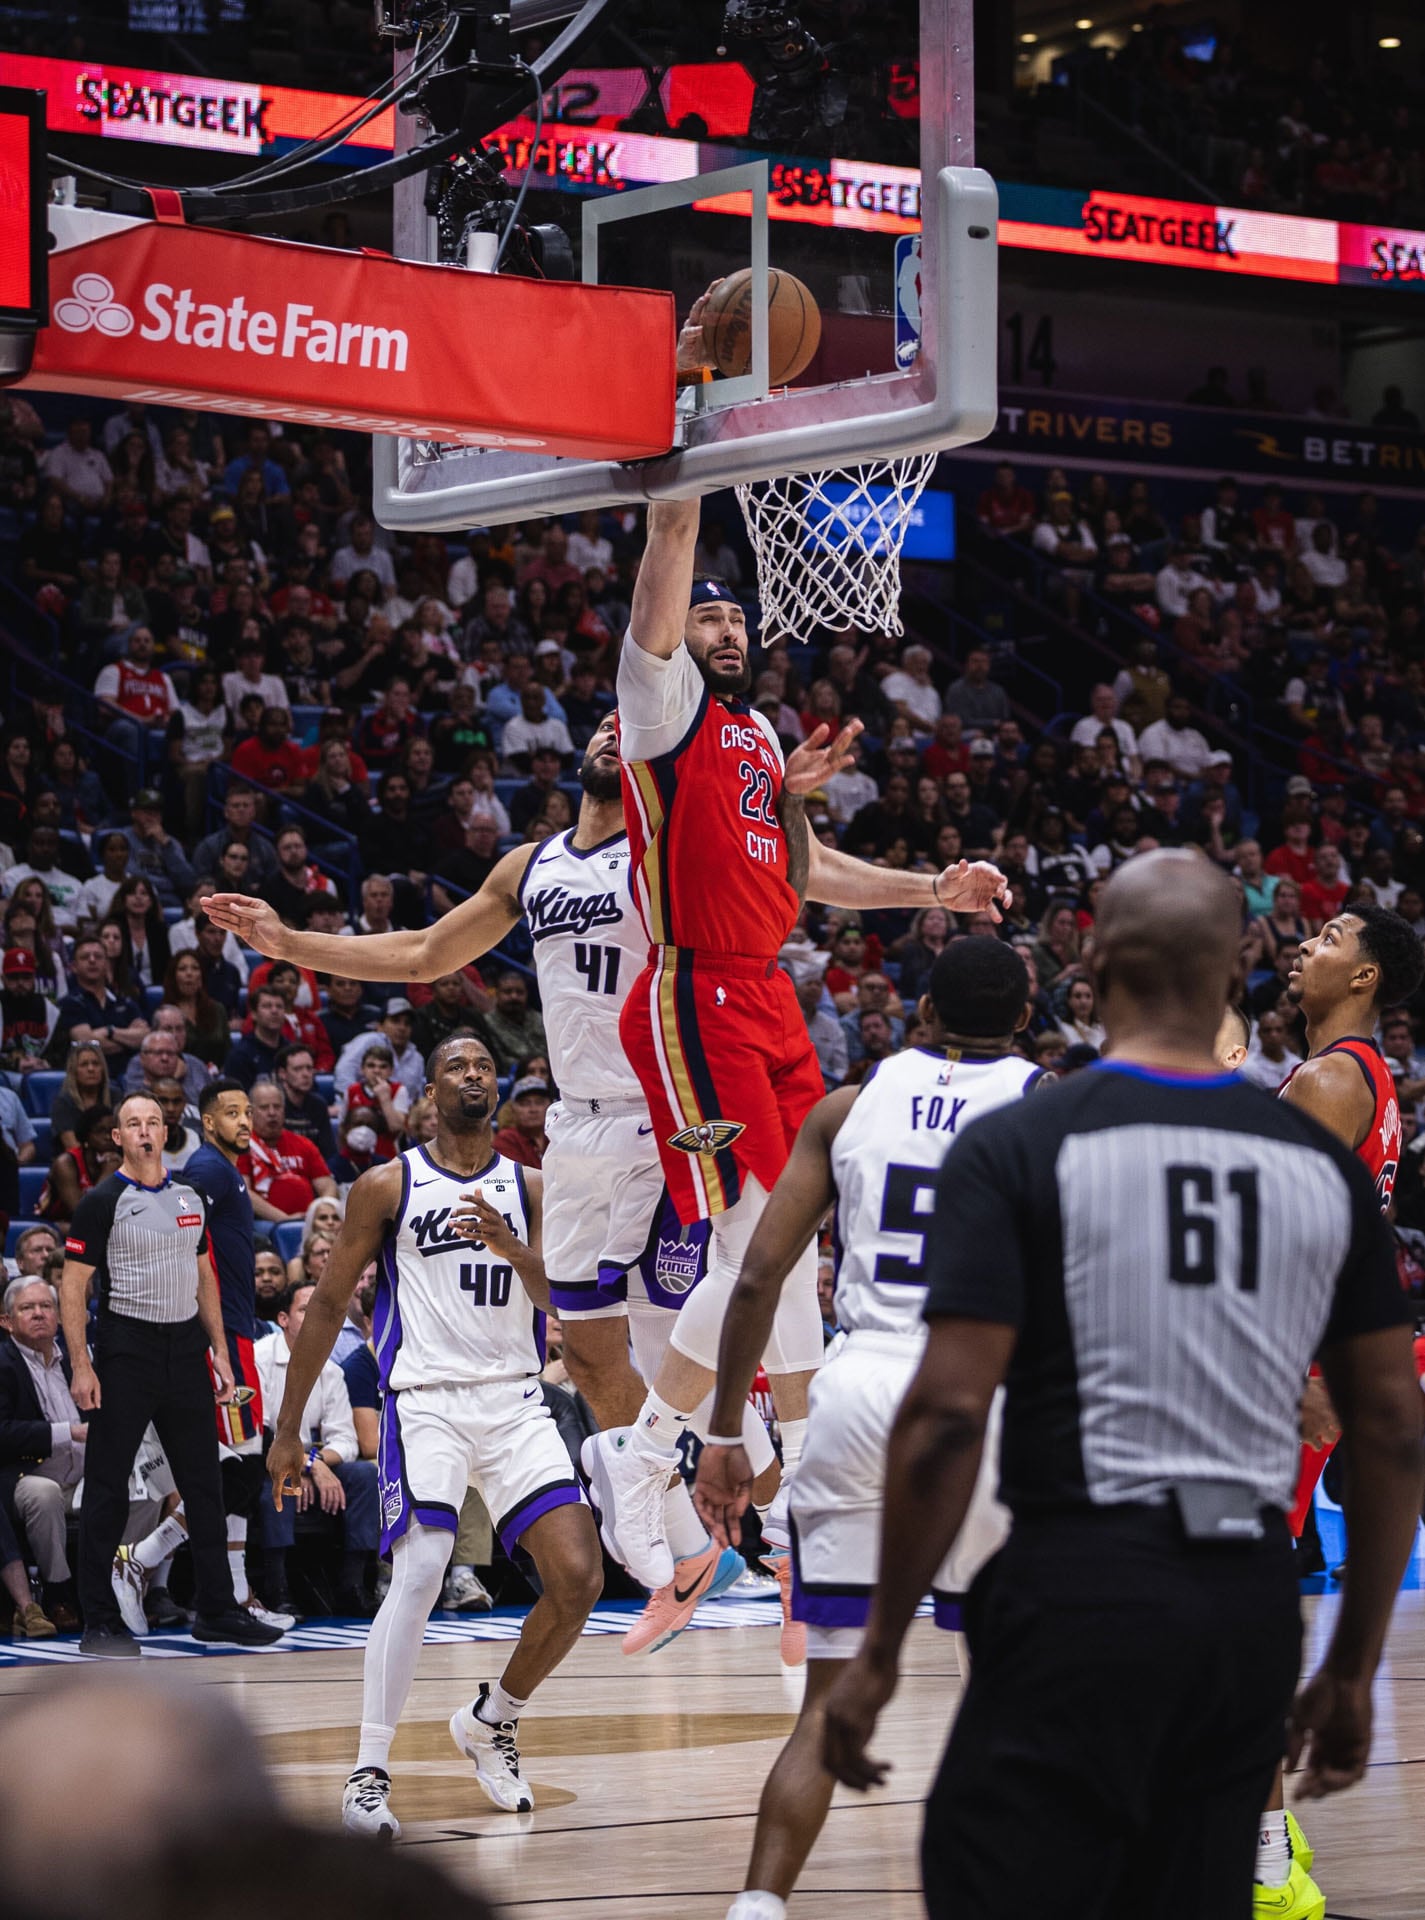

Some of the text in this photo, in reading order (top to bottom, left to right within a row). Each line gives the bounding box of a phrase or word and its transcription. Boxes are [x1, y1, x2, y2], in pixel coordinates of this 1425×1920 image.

[79, 74, 273, 144] SEATGEEK
[771, 164, 922, 218] SEATGEE
[1085, 203, 1238, 259] SEATGEEK
[992, 406, 1174, 449] TRIVERS
[738, 760, 779, 829] 22
[746, 831, 778, 864] CITY
[527, 886, 624, 942] Kings
[573, 943, 622, 995] 41
[911, 1096, 967, 1133] FOX
[873, 1161, 938, 1287] 5
[1164, 1164, 1259, 1291] 61
[460, 1264, 514, 1307] 40
[657, 1260, 697, 1275] KINGS
